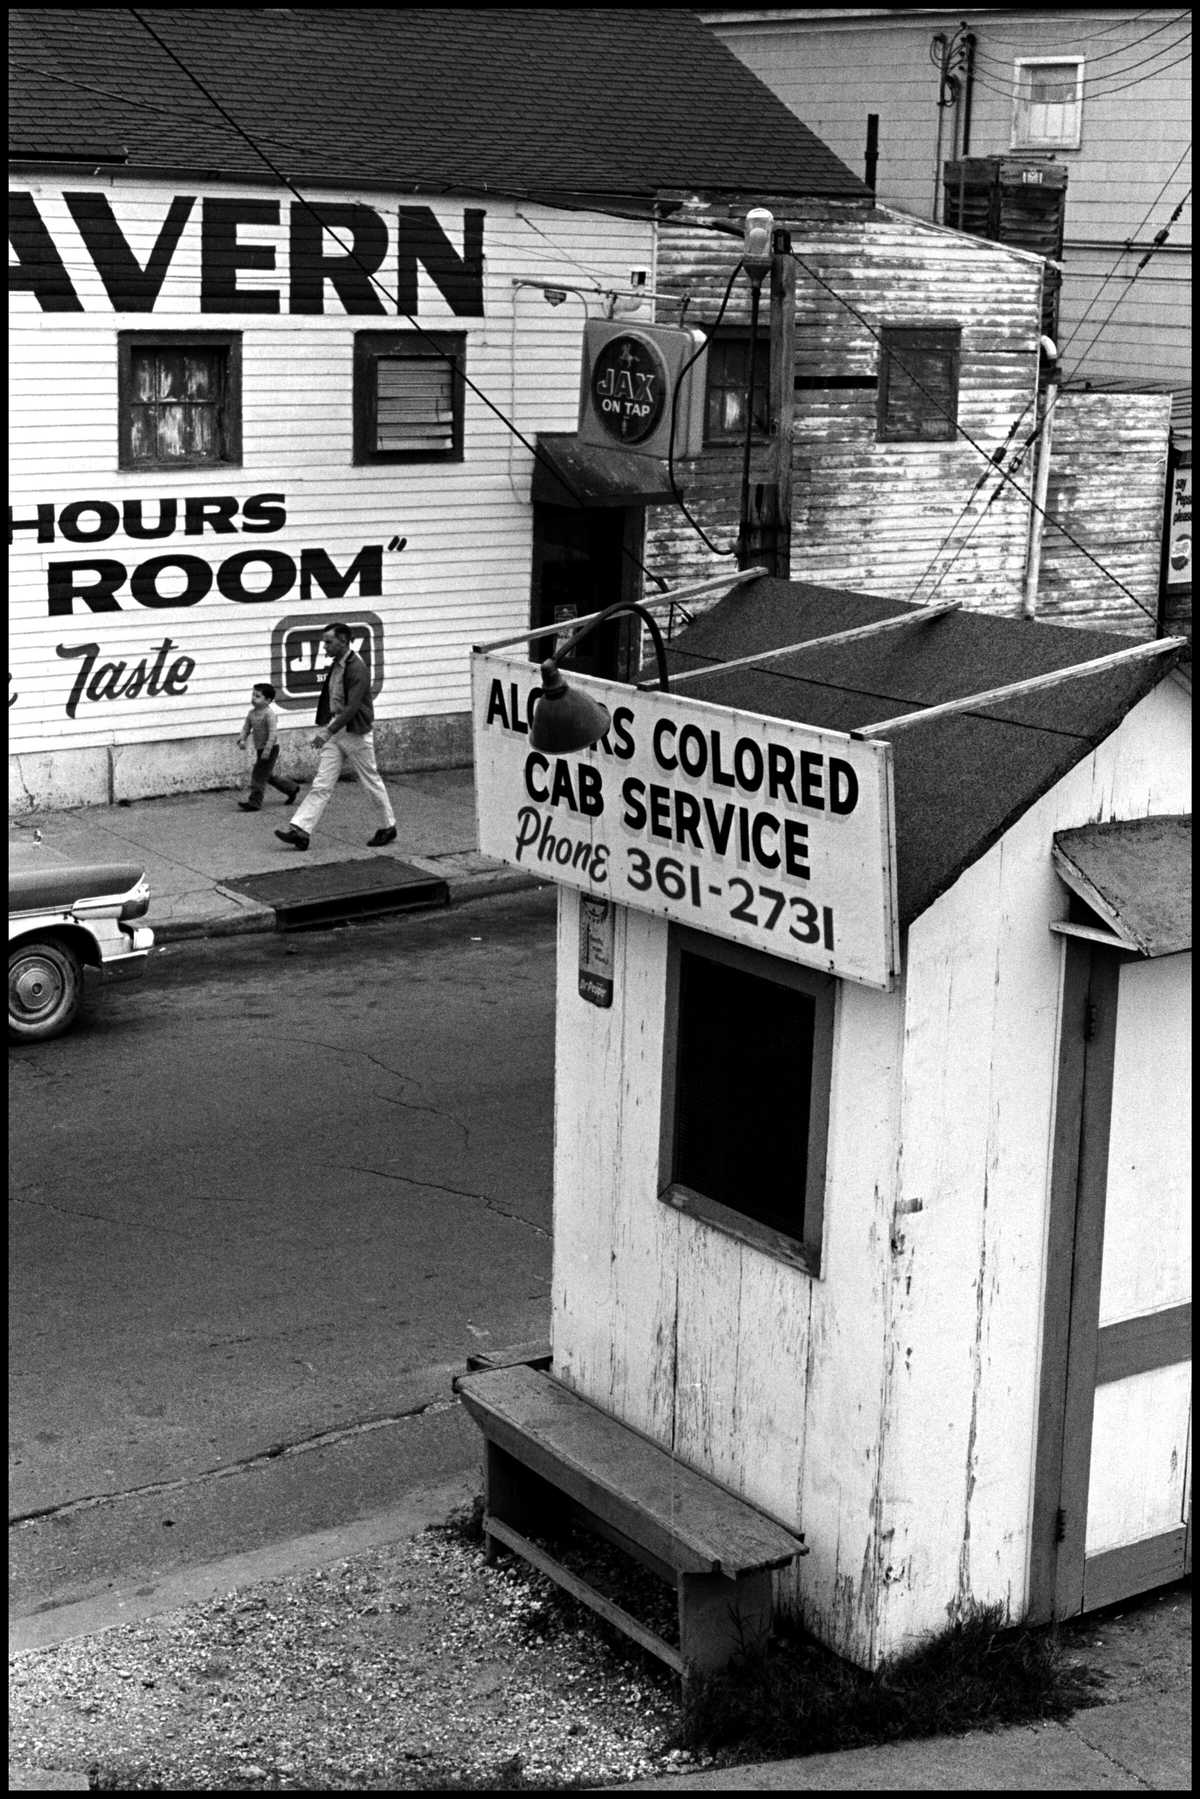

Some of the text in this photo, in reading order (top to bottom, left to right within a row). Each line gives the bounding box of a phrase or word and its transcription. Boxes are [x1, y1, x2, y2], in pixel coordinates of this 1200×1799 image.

[597, 368, 655, 401] JAX
[602, 399, 650, 417] ON TAP
[8, 493, 286, 545] HOURS
[56, 638, 196, 720] Taste
[653, 719, 859, 816] COLORED
[525, 752, 811, 880] CAB SERVICE
[516, 806, 835, 951] Phone 361-2731
